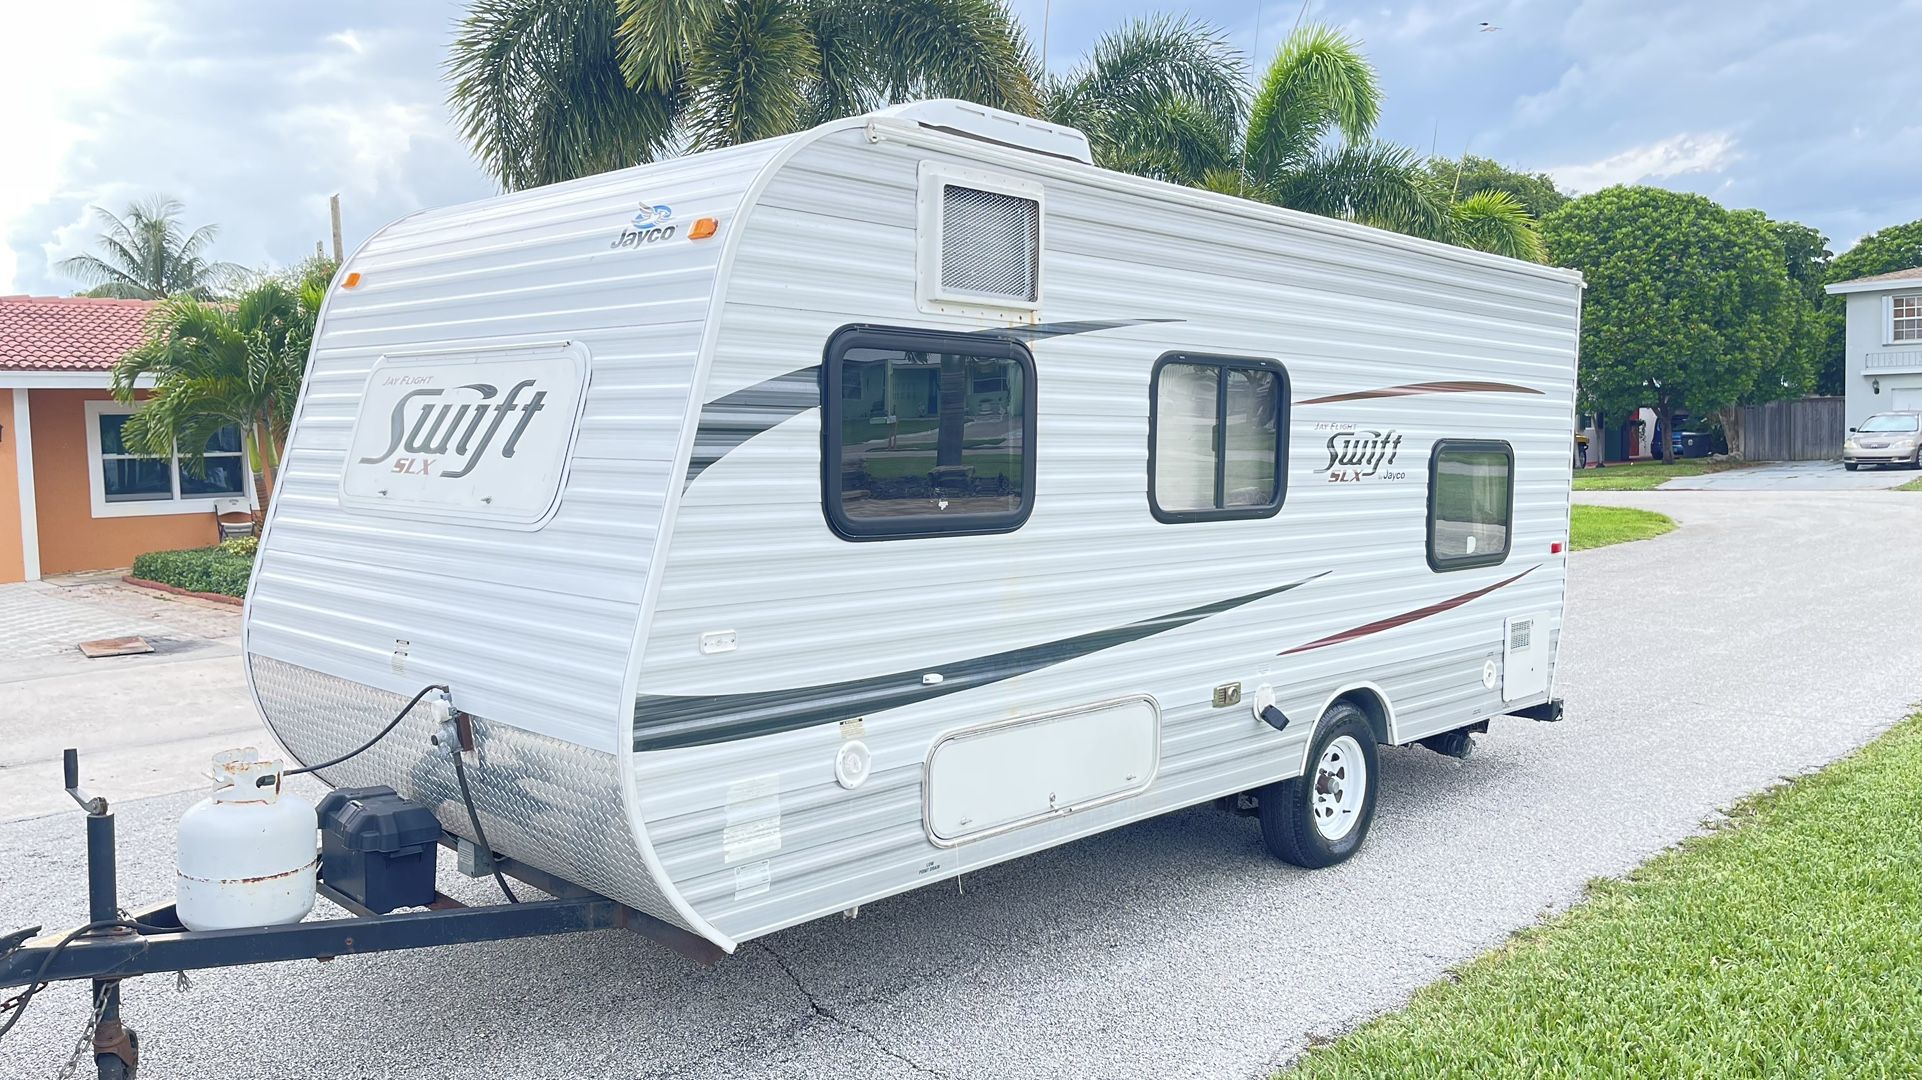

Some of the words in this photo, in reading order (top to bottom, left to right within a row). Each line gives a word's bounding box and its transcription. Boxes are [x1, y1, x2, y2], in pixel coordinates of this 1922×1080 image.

[610, 226, 675, 249] Jayco
[382, 376, 401, 386] JAY
[400, 375, 434, 385] FLIGHT
[358, 380, 547, 478] Swift
[1314, 422, 1329, 430] JAY
[1330, 422, 1357, 430] FLIGHT
[1313, 430, 1402, 476] Swift
[391, 458, 437, 475] SLX
[1328, 470, 1362, 482] SLX
[1383, 469, 1405, 481] Jayco
